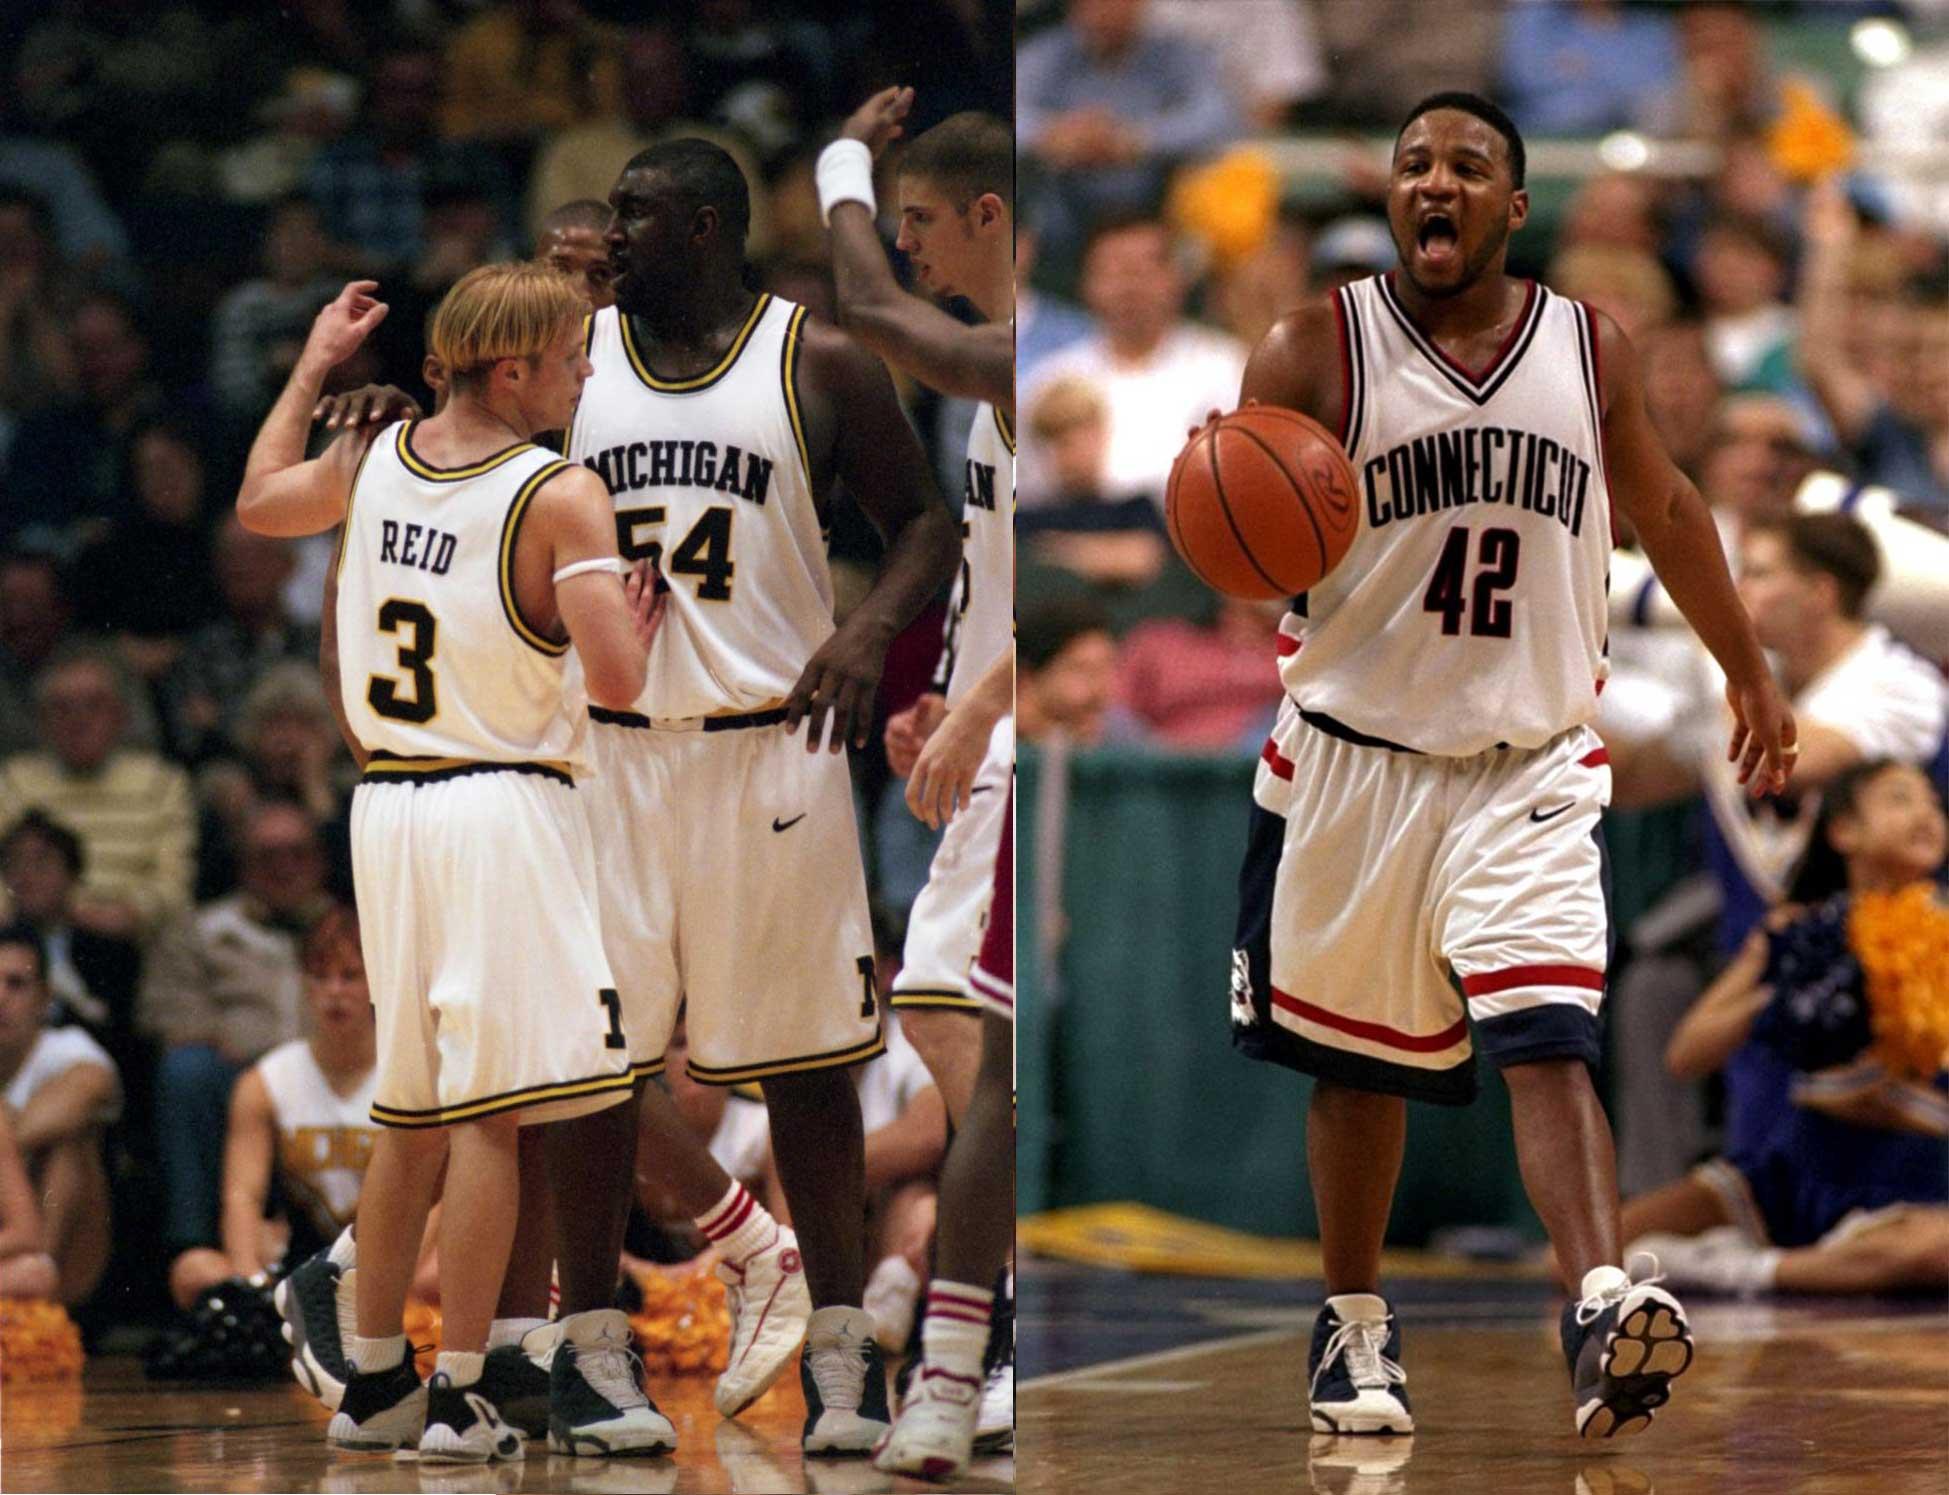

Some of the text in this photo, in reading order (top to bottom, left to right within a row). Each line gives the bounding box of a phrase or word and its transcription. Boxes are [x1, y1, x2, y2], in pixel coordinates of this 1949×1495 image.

[584, 440, 774, 506] MICHIGAN
[1364, 426, 1591, 539] CONNECTICUT
[380, 519, 458, 576] REID
[614, 505, 736, 604] 54
[1422, 526, 1520, 638] 42
[367, 594, 439, 724] 3
